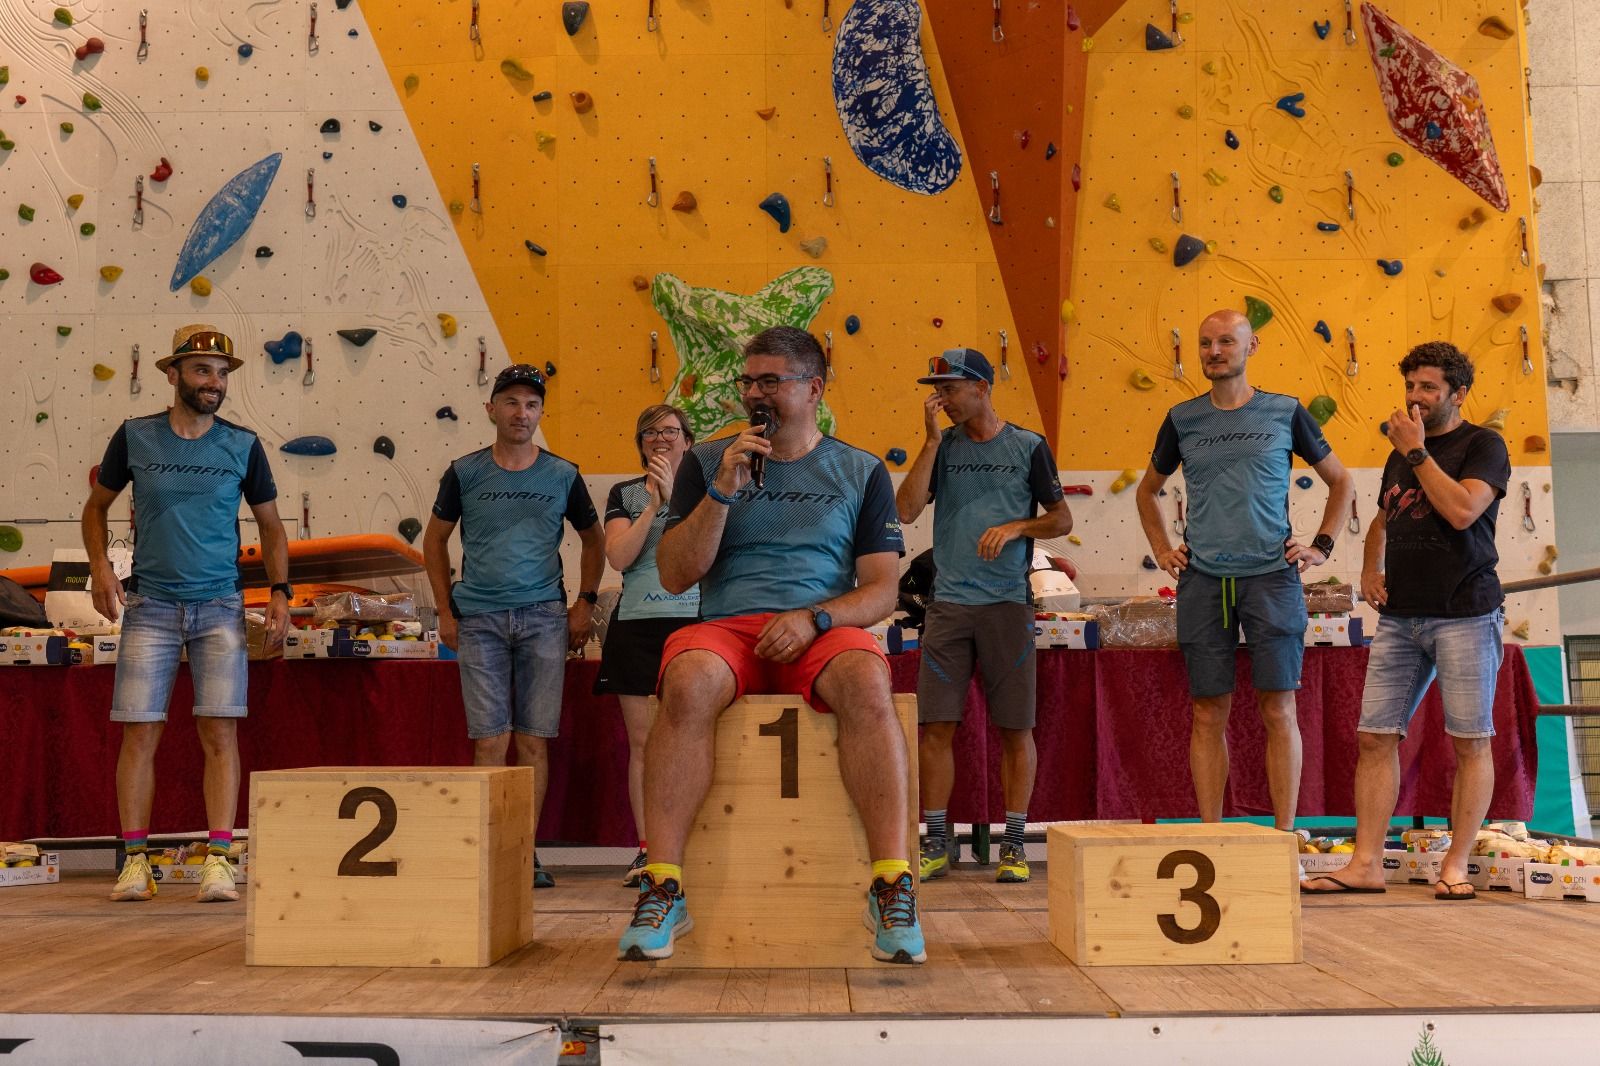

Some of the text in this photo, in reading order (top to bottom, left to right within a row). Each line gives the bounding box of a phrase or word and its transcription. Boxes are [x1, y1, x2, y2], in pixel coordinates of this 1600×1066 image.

[1195, 432, 1276, 448] DYNAFIT
[144, 463, 234, 476] DYNAFIT
[945, 463, 1020, 474] DYNAFIT
[477, 491, 557, 502] DYNAFIT
[759, 708, 799, 798] 1
[338, 787, 397, 876] 2
[1157, 850, 1221, 944] 3
